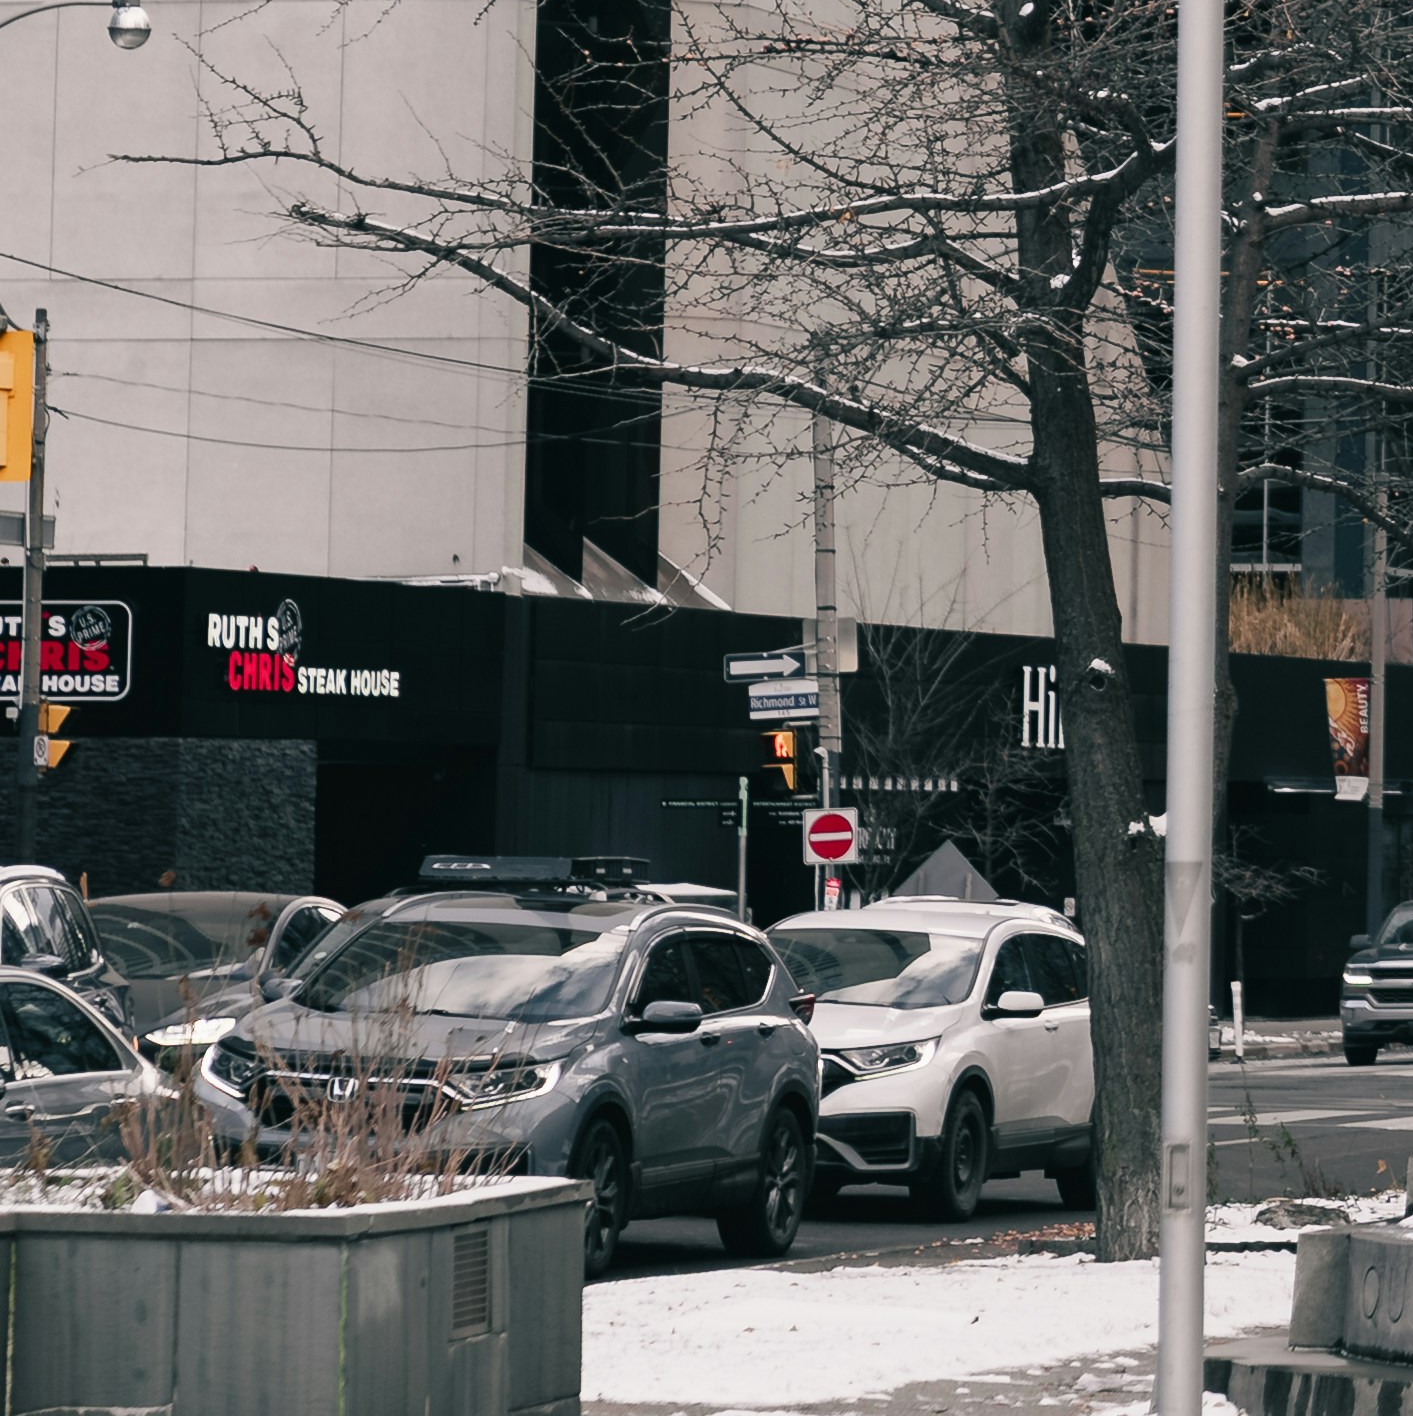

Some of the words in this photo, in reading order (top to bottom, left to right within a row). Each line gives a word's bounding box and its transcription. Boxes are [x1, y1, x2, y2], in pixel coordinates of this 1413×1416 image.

[207, 613, 281, 651] RUTHS
[41, 674, 120, 693] HOUSE
[228, 650, 296, 694] CHRIS
[297, 666, 348, 695] STEAK
[350, 668, 401, 698] HOUSE
[750, 695, 795, 710] Richmond
[807, 693, 817, 705] W
[1356, 683, 1369, 734] BEAUTY
